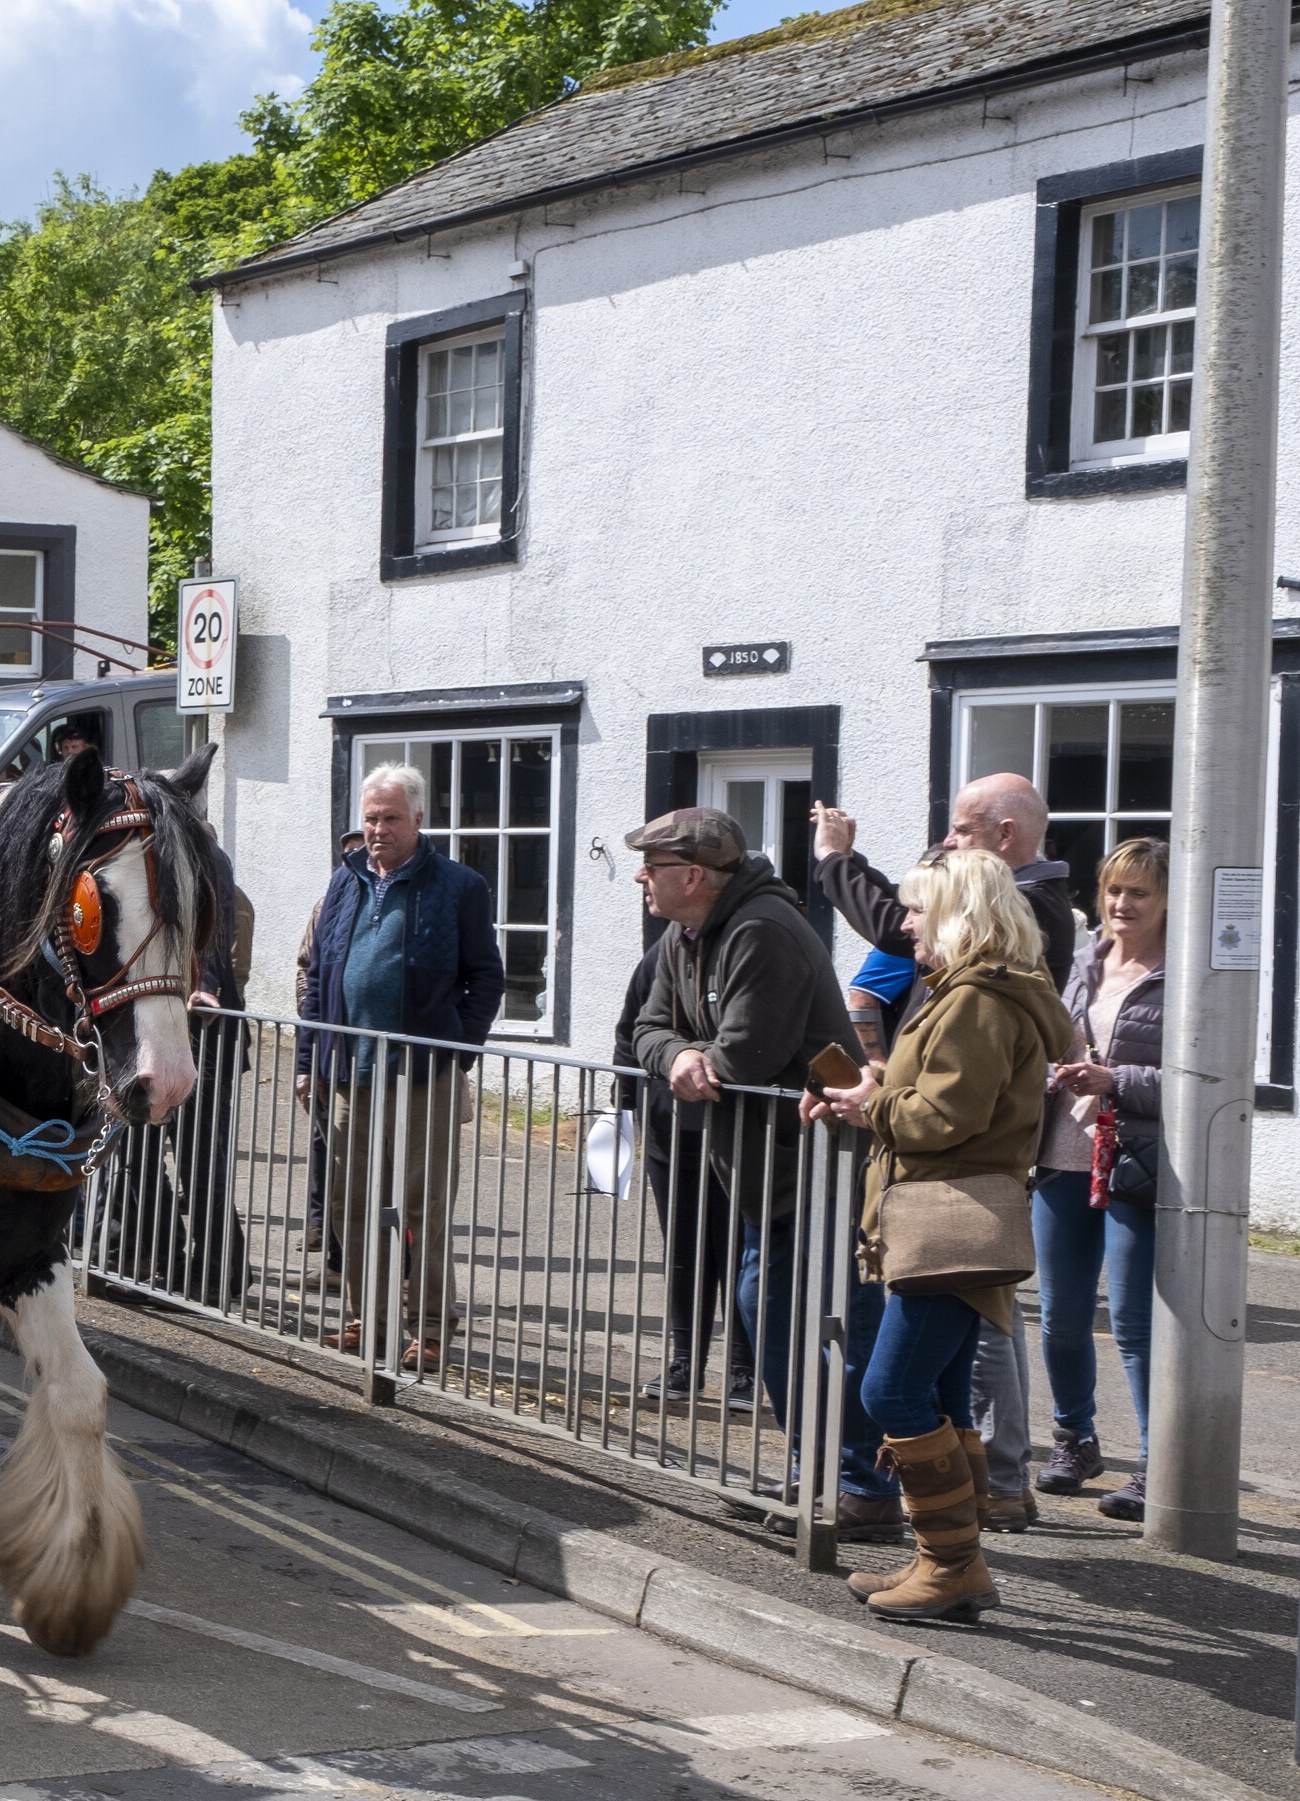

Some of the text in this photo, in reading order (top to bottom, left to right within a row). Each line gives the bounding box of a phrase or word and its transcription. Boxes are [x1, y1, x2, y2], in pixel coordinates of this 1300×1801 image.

[194, 611, 222, 644] 20
[729, 650, 759, 665] 1850
[188, 676, 223, 697] ZONE
